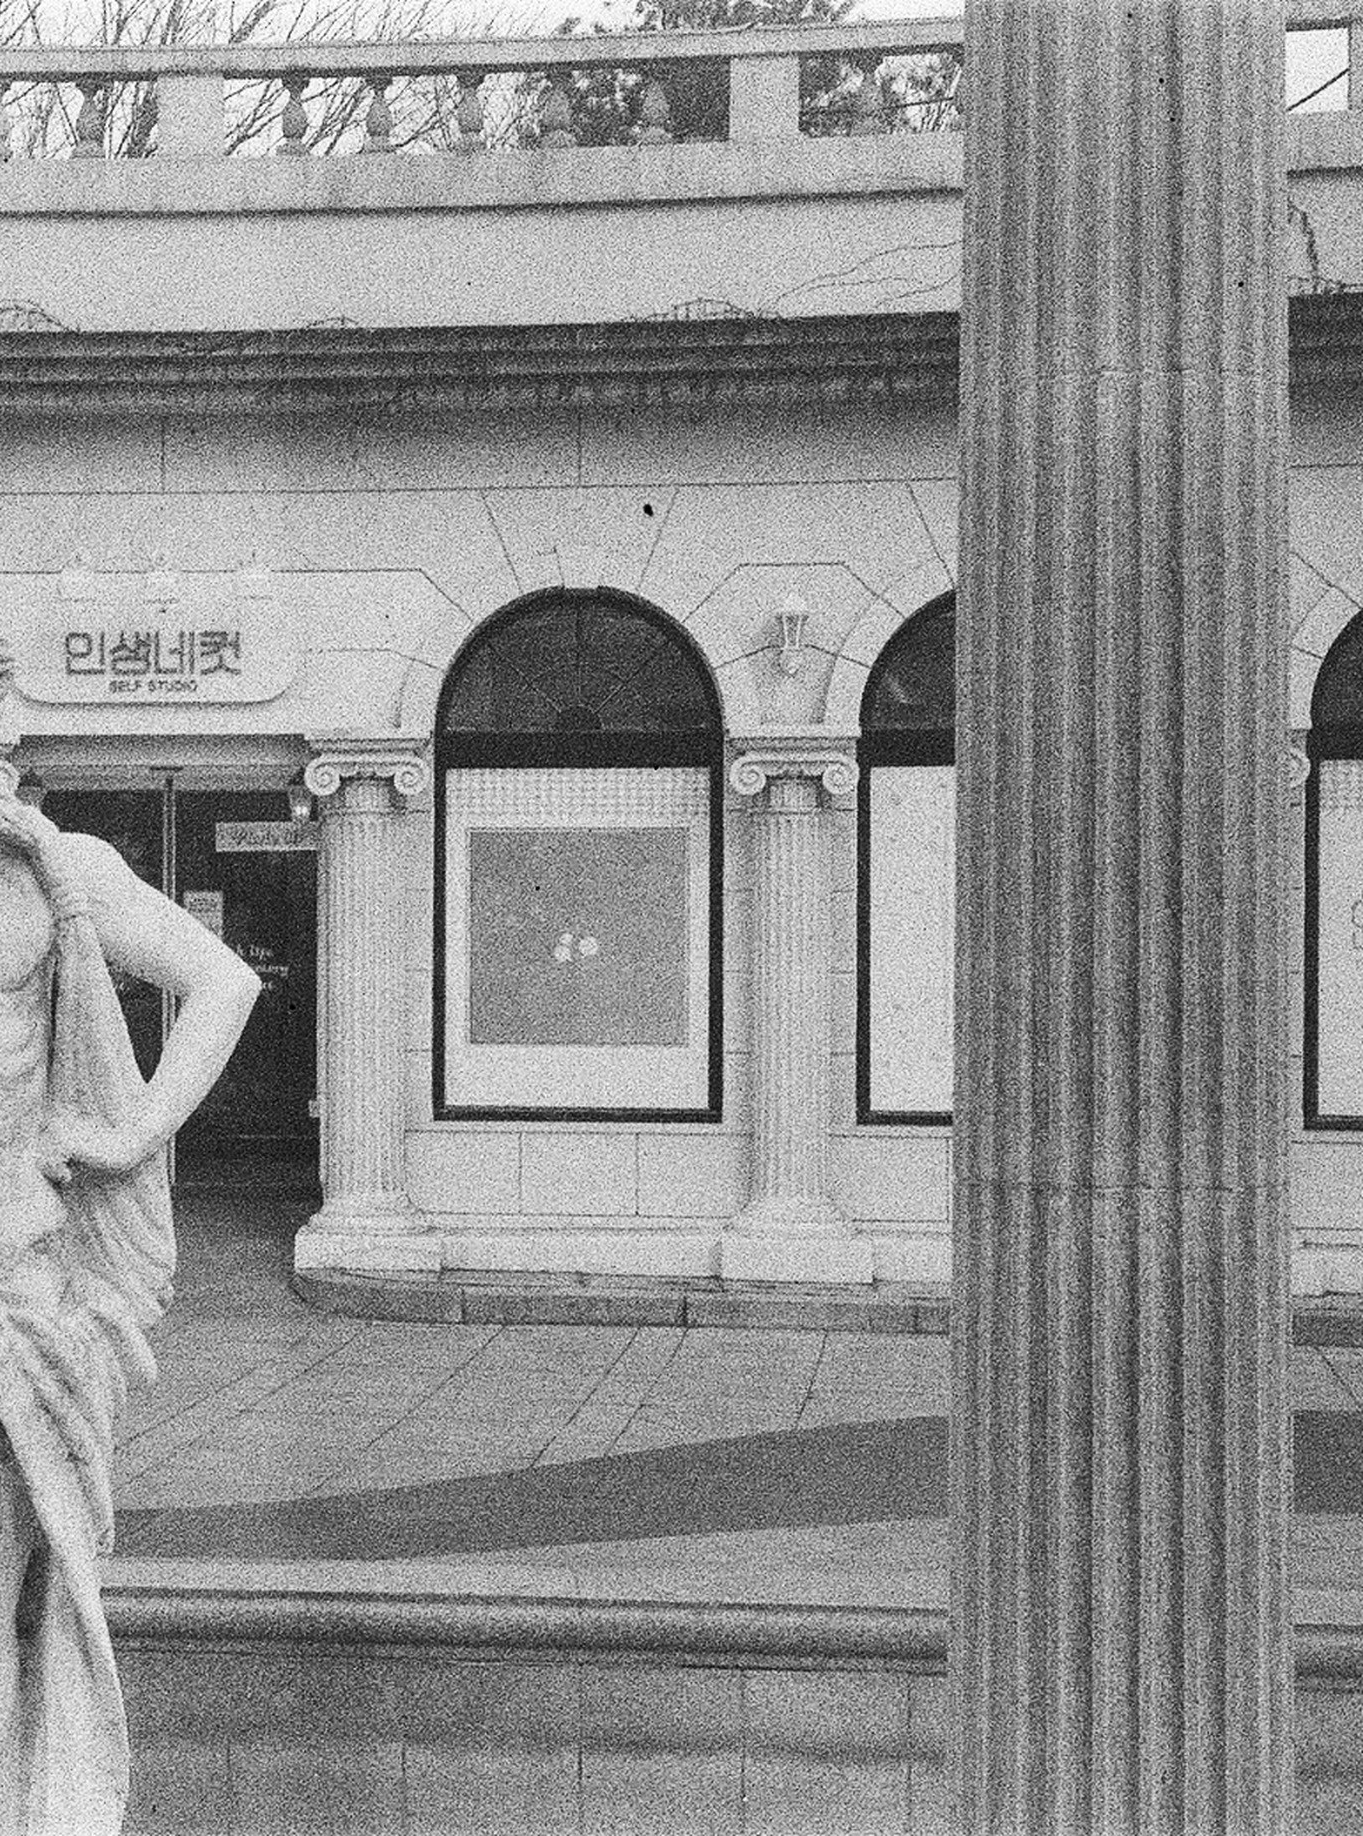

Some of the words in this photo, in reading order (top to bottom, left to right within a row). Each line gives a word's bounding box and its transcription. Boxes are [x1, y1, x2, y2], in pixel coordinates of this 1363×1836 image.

[64, 630, 242, 676] 인생네컷
[108, 679, 142, 692] SELF
[147, 679, 198, 692] STUDIO
